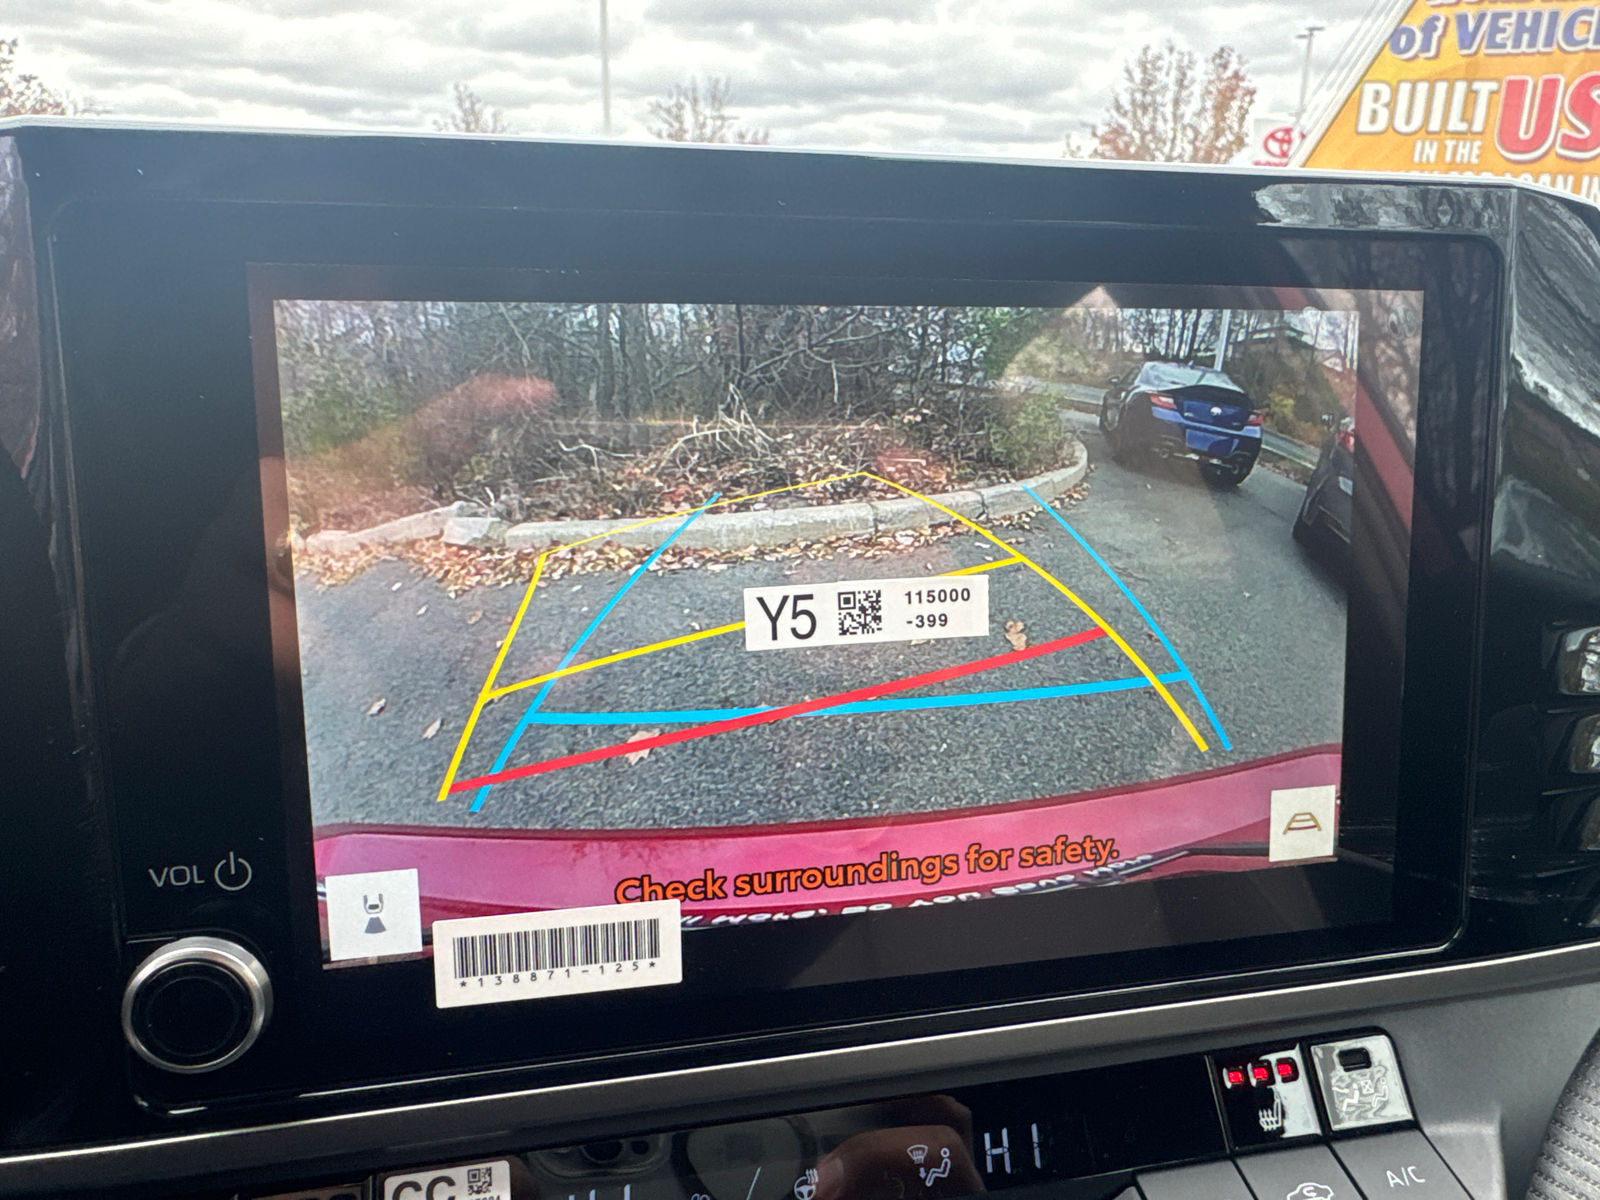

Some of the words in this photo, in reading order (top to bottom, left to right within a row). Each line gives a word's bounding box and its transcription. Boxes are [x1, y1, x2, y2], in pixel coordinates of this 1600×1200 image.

[1389, 14, 1447, 58] of
[1355, 80, 1498, 135] BUILT
[1413, 139, 1438, 164] IN
[1444, 139, 1483, 164] THE
[904, 587, 971, 605] 115000
[756, 592, 817, 641] Y5
[906, 613, 949, 629] -399
[148, 865, 205, 888] VOL
[614, 868, 728, 904] Check
[733, 850, 958, 897] surroundings
[966, 844, 1014, 873] for
[1019, 835, 1119, 869] safety.
[983, 1122, 1042, 1175] HI
[1386, 1166, 1426, 1188] A/C
